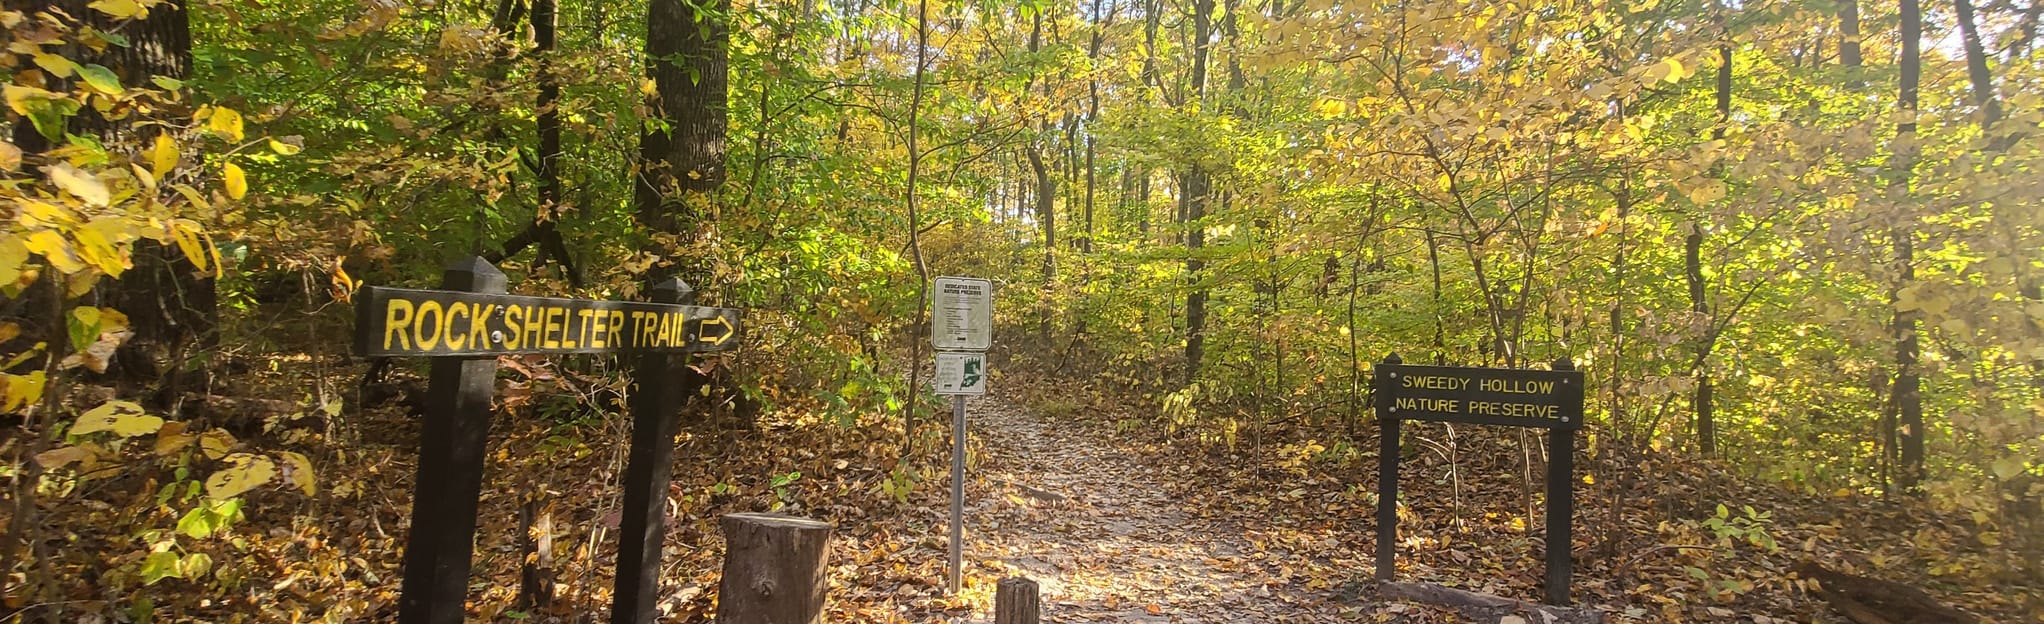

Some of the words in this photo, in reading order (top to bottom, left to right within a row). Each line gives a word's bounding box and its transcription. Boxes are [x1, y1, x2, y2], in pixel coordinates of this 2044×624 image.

[383, 298, 496, 351] ROCK
[502, 305, 625, 351] SHELTER
[631, 310, 685, 348] TRAIL
[1402, 375, 1470, 390] SWEEDY
[1480, 378, 1554, 394] HOLLOW
[1396, 397, 1459, 412] NATURE
[1469, 401, 1560, 419] PRESERVE
